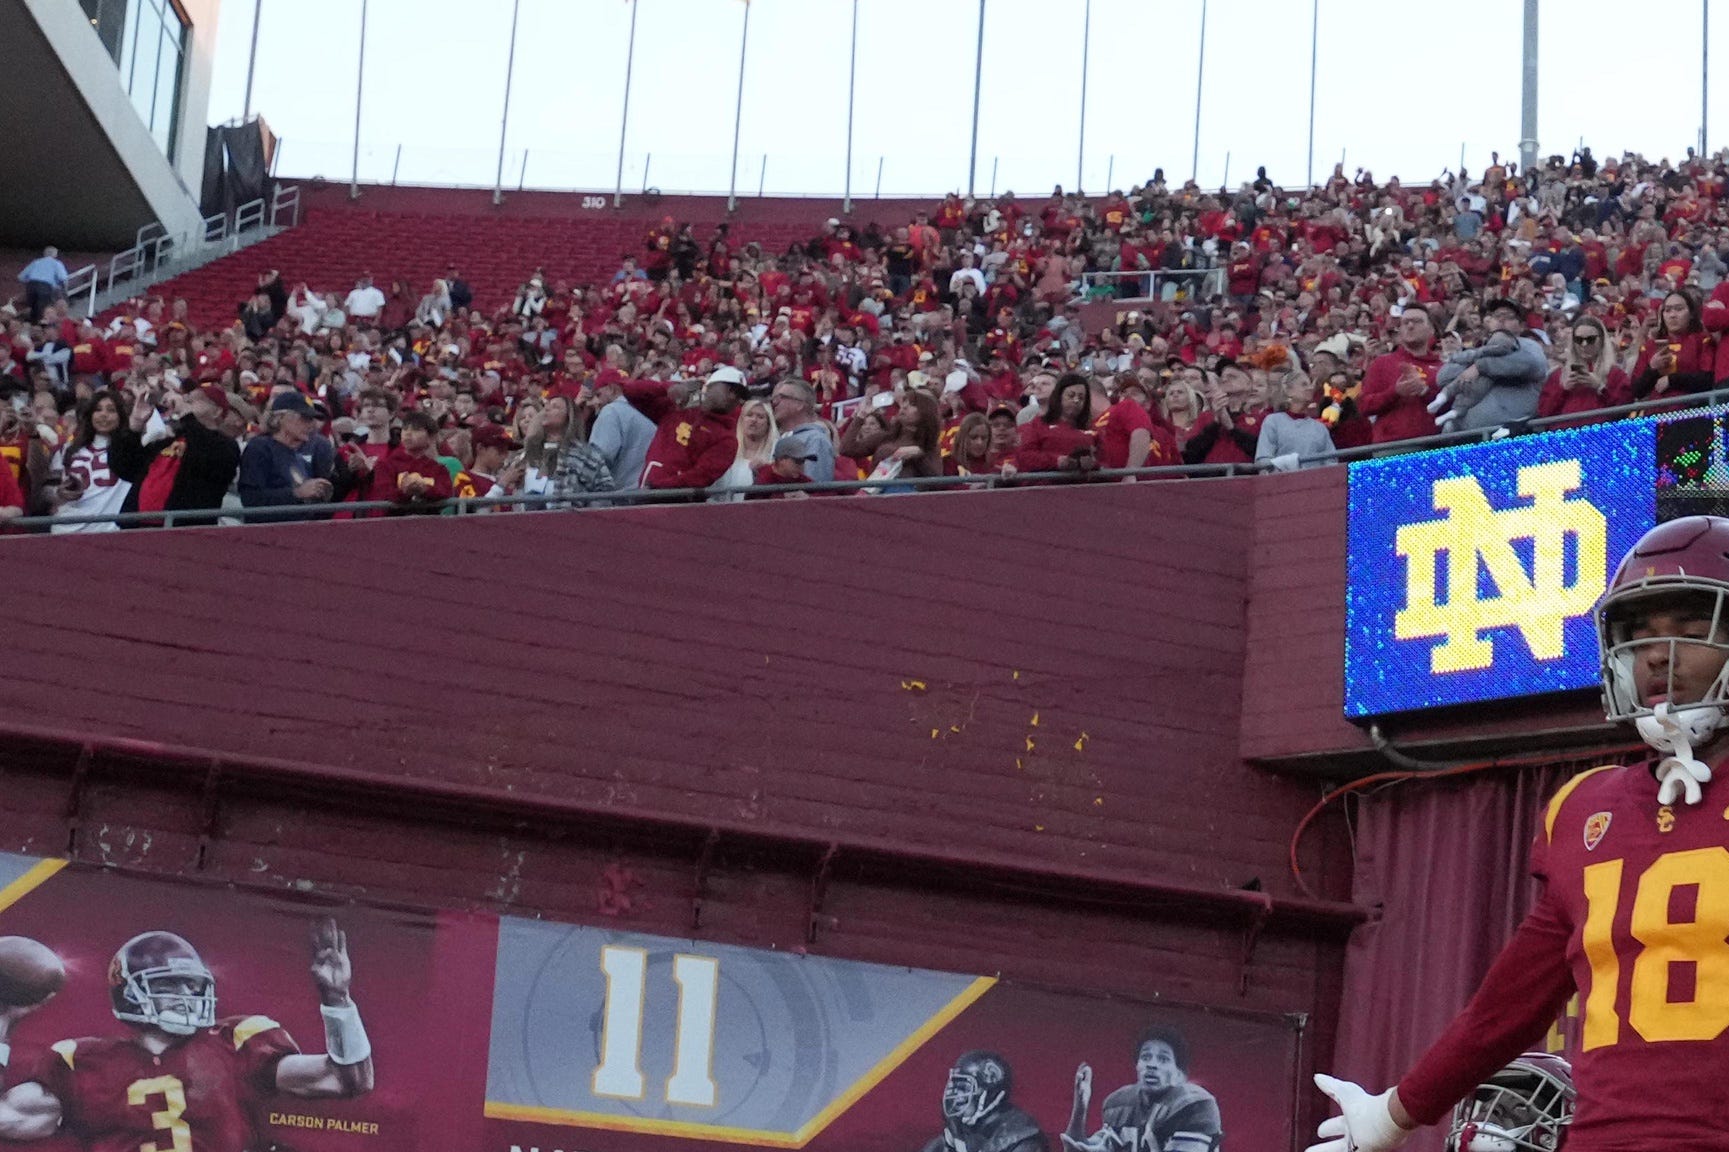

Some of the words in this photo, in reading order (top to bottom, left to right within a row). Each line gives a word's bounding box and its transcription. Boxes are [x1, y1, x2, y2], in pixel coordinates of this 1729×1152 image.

[591, 945, 719, 1106] 11
[269, 1112, 323, 1129] CARSON
[327, 1118, 379, 1135] PALMER
